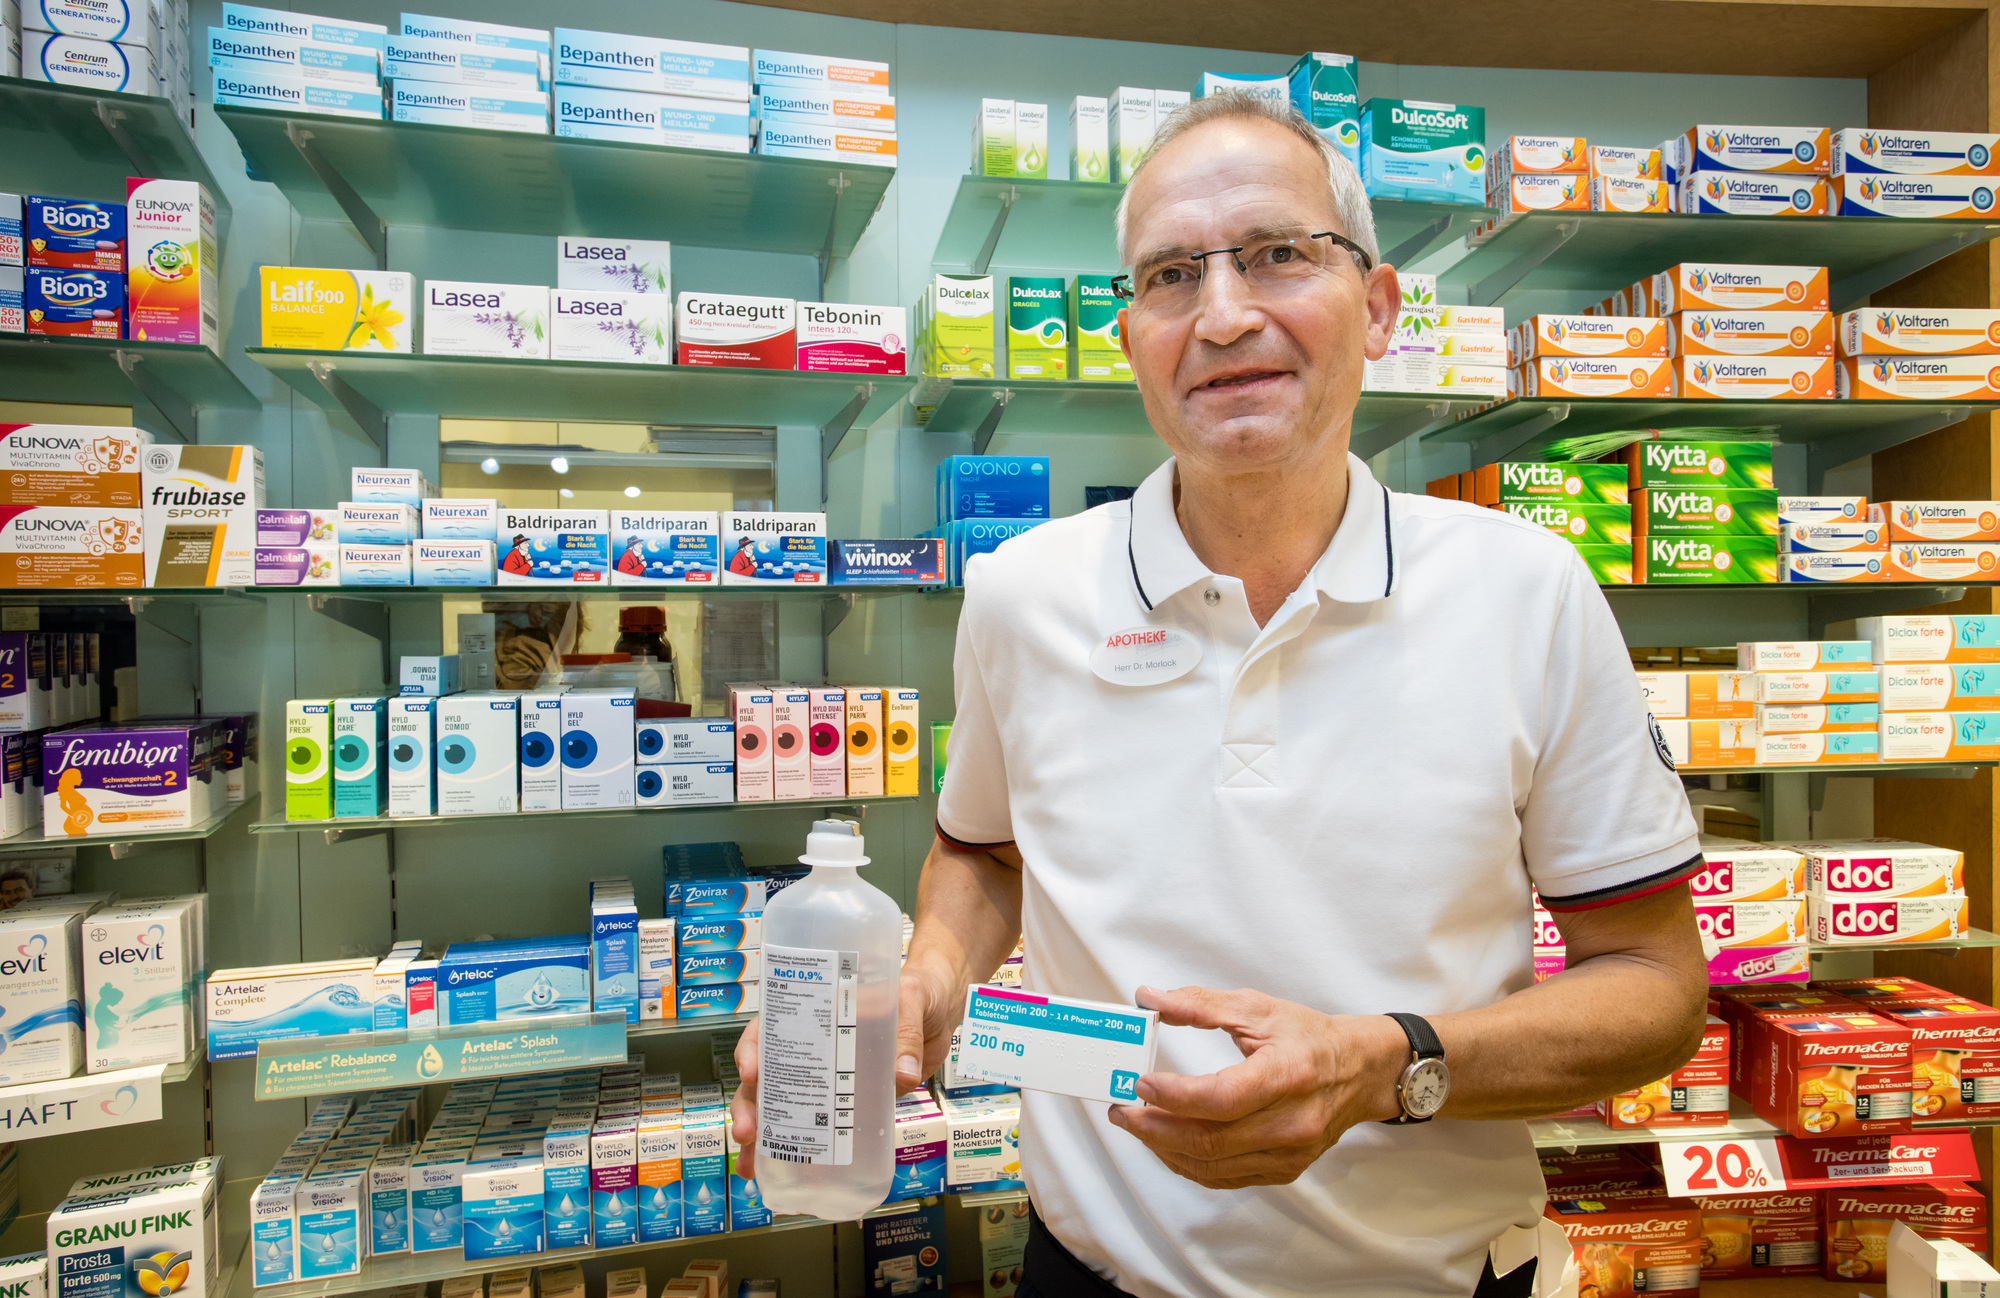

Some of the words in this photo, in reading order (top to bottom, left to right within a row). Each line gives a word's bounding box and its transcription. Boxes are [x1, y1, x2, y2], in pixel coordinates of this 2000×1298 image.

[49, 8, 102, 23] GENERATION
[106, 16, 121, 24] 50+
[212, 38, 295, 60] Bepanthen
[559, 43, 655, 69] Bepanthen
[64, 50, 108, 64] Centrum
[757, 59, 824, 77] Bepanthen
[218, 78, 301, 99] Bepanthen
[397, 90, 466, 108] Bepanthen
[1313, 91, 1357, 105] DulcoSoft
[560, 101, 656, 124] Bepanthen
[1391, 108, 1469, 130] DulcoSoft
[765, 130, 832, 147] Bepanthen
[1725, 132, 1780, 148] Voltaren
[1878, 136, 1931, 150] Voltaren
[1597, 149, 1636, 160] Voltaren
[1725, 181, 1779, 195] Voltaren
[135, 200, 191, 212] EUNOVA
[43, 205, 110, 230] Bion3
[135, 209, 182, 222] Junior
[563, 242, 626, 261] Lasea
[1709, 272, 1761, 286] Voltaren
[270, 281, 315, 303] Laif
[315, 289, 344, 304] 900
[431, 289, 500, 307] Lasea
[940, 288, 989, 299] Dulcolax
[1013, 288, 1061, 298] DulcoLax
[270, 303, 325, 314] BALANCE
[557, 296, 623, 316] Lasea
[686, 299, 785, 322] Crataegutt
[804, 307, 881, 326] Tebonin
[1896, 315, 1949, 328] Voltaren
[715, 321, 777, 330] Herz-Kreislauf-Tabletten
[1460, 344, 1494, 356] Gastritol
[1713, 364, 1766, 377] Voltaren
[10, 437, 80, 449] EUNOVA
[10, 452, 70, 460] MULTIVITAMIN
[1646, 445, 1708, 472] Kytta
[11, 460, 60, 468] VivaChrono
[959, 462, 1020, 475] OYONO
[357, 474, 410, 485] Neurexan
[1504, 464, 1563, 491] Kytta
[152, 485, 245, 505] frubiase
[167, 509, 233, 518] SPORT
[429, 506, 488, 517] Neurexan
[15, 519, 86, 532] EUNOVA
[507, 516, 597, 530] Baldriparan
[621, 517, 708, 532] Baldriparan
[256, 552, 305, 563] Calmalaif
[846, 549, 912, 566] vivinox
[1653, 540, 1712, 565] Kytta
[1107, 630, 1166, 647] APOTHEKE
[1888, 628, 1918, 638] Diclox
[1921, 628, 1944, 637] forte
[1115, 664, 1131, 672] Herr
[1134, 662, 1143, 670] Dr.
[1146, 660, 1176, 668] Morlock
[49, 739, 178, 775] femibion
[102, 775, 161, 784] Schwangerschaft
[164, 771, 177, 785] 2
[1894, 856, 1923, 865] Ibuprofen
[1894, 863, 1928, 872] Schmerzgel
[1830, 859, 1890, 889] doc
[686, 887, 727, 903] Zovirax
[1835, 902, 1895, 933] doc
[682, 925, 725, 940] Zovirax
[99, 943, 165, 965] elevit
[683, 957, 726, 973] Zovirax
[448, 969, 494, 984] Artelac
[774, 968, 795, 978] NaCl
[799, 971, 822, 980] 0,9%
[215, 984, 265, 996] Artelac
[767, 981, 778, 989] 500
[215, 994, 266, 1006] Complete
[975, 1009, 1008, 1020] Tabletten
[976, 999, 1027, 1015] Doxycyclin
[1030, 1007, 1047, 1017] 200
[1071, 1015, 1099, 1026] Pharma
[1105, 1019, 1123, 1029] 200
[1125, 1024, 1141, 1034] mg
[972, 1022, 1000, 1031] Doxycyclin
[463, 1039, 513, 1054] Artelac
[521, 1035, 558, 1050] Splash
[970, 1032, 997, 1049] 200
[1002, 1040, 1024, 1057] mg
[1803, 1042, 1909, 1056] ThermaCare
[267, 1059, 322, 1074] Artelac
[331, 1052, 397, 1067] Rebalance
[482, 1055, 501, 1063] leichte
[513, 1051, 536, 1059] mittlere
[537, 1049, 566, 1059] Symptome
[495, 1060, 531, 1070] Befeuchtung
[543, 1055, 582, 1065] Kontaktlinsen
[274, 1076, 286, 1084] Für
[287, 1074, 312, 1083] mittlere
[325, 1071, 350, 1079] schwere
[352, 1067, 387, 1078] Symptome
[287, 1080, 324, 1091] chronischen
[327, 1074, 394, 1089] Tränenfilmstörungen
[953, 1128, 1001, 1140] Biolectra
[770, 1142, 798, 1152] BRAUN
[954, 1138, 1002, 1148] MAGNESIUM
[548, 1149, 583, 1159] VISION
[1812, 1145, 1937, 1163] ThermaCare
[1683, 1143, 1749, 1189] 20
[1747, 1166, 1767, 1187] %
[1833, 1167, 1851, 1176] 2er-
[1853, 1166, 1869, 1175] und
[1871, 1163, 1925, 1176] 3er-Packung
[1838, 1199, 1976, 1216] ThermaCare
[55, 1219, 136, 1248] GRANU
[141, 1210, 192, 1234] FINK
[890, 1217, 928, 1228] RATGEBER
[1564, 1219, 1689, 1236] ThermaCare
[876, 1238, 892, 1246] UND
[894, 1232, 931, 1243] FUSSPILZ
[63, 1253, 111, 1272] Prosta
[64, 1275, 91, 1288] forte
[93, 1274, 109, 1284] 500
[111, 1272, 121, 1280] mg
